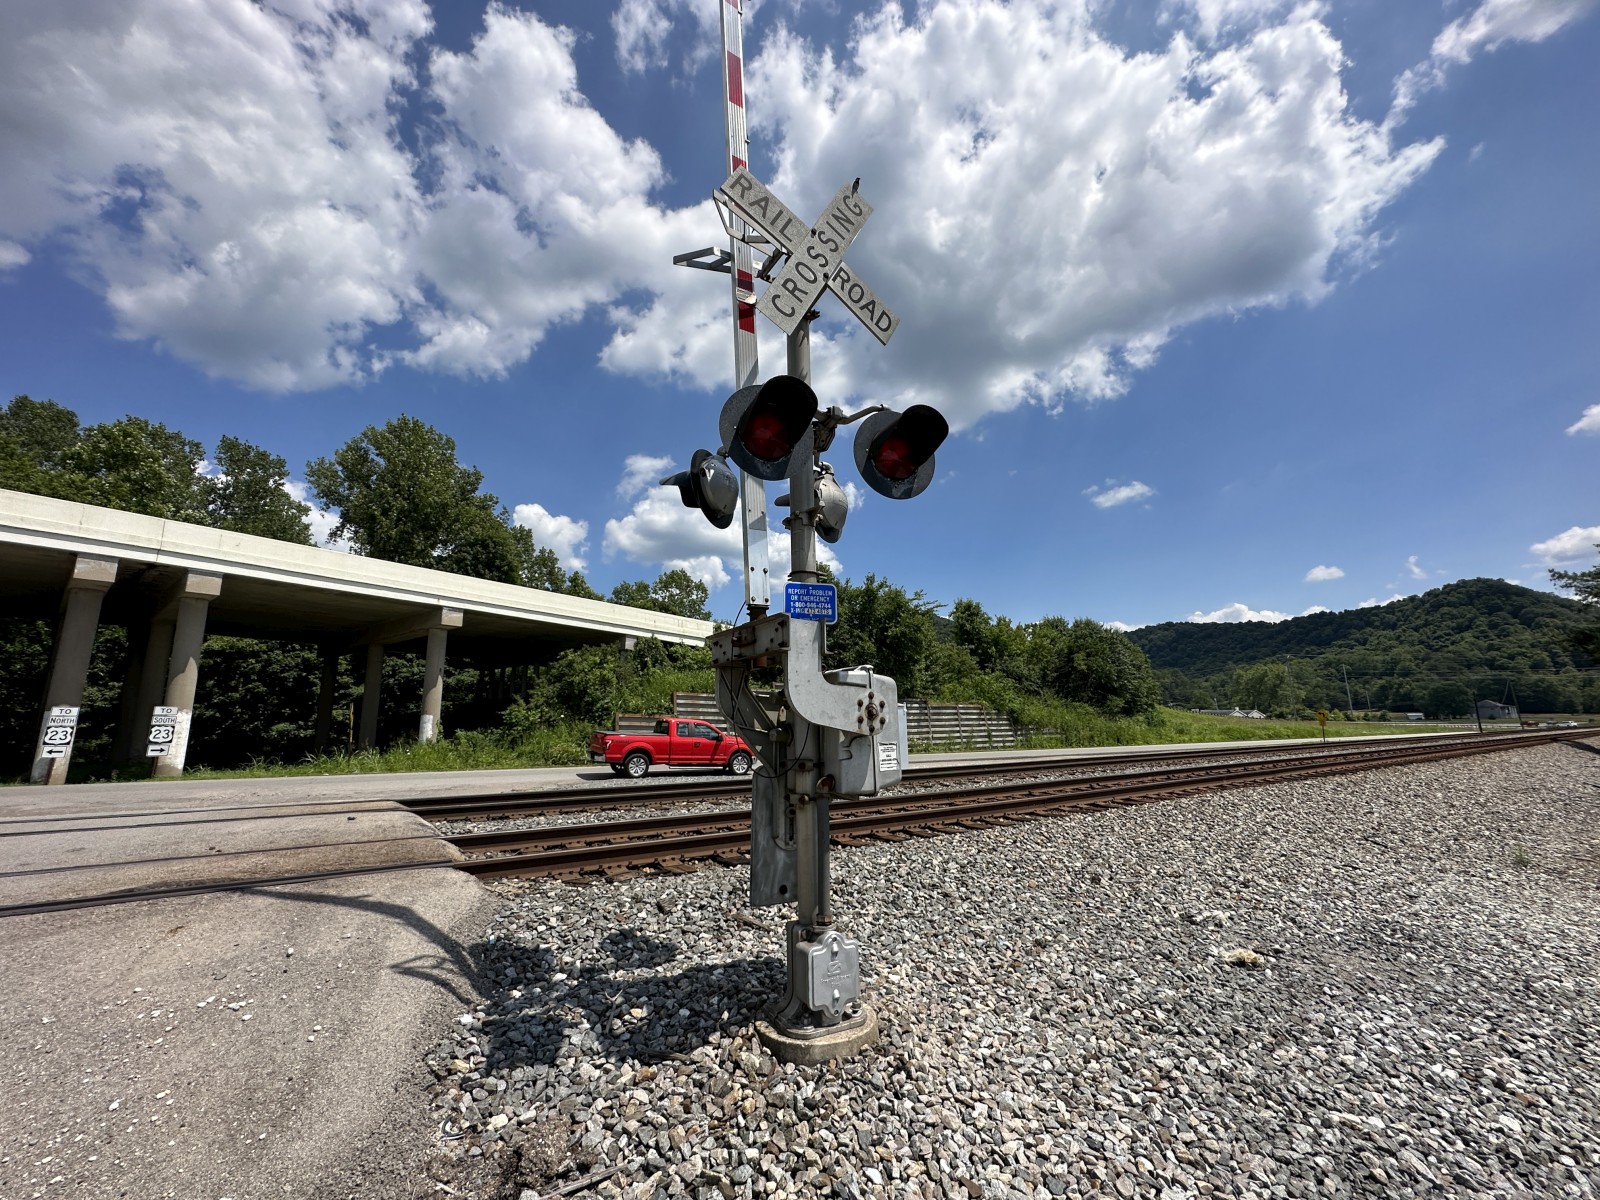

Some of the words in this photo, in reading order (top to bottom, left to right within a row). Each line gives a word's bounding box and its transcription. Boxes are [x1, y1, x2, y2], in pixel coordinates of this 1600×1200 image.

[729, 173, 794, 243] RAIL
[832, 266, 892, 333] ROAD
[771, 194, 863, 318] CROSSING
[48, 730, 69, 741] 23
[152, 729, 170, 740] 23
